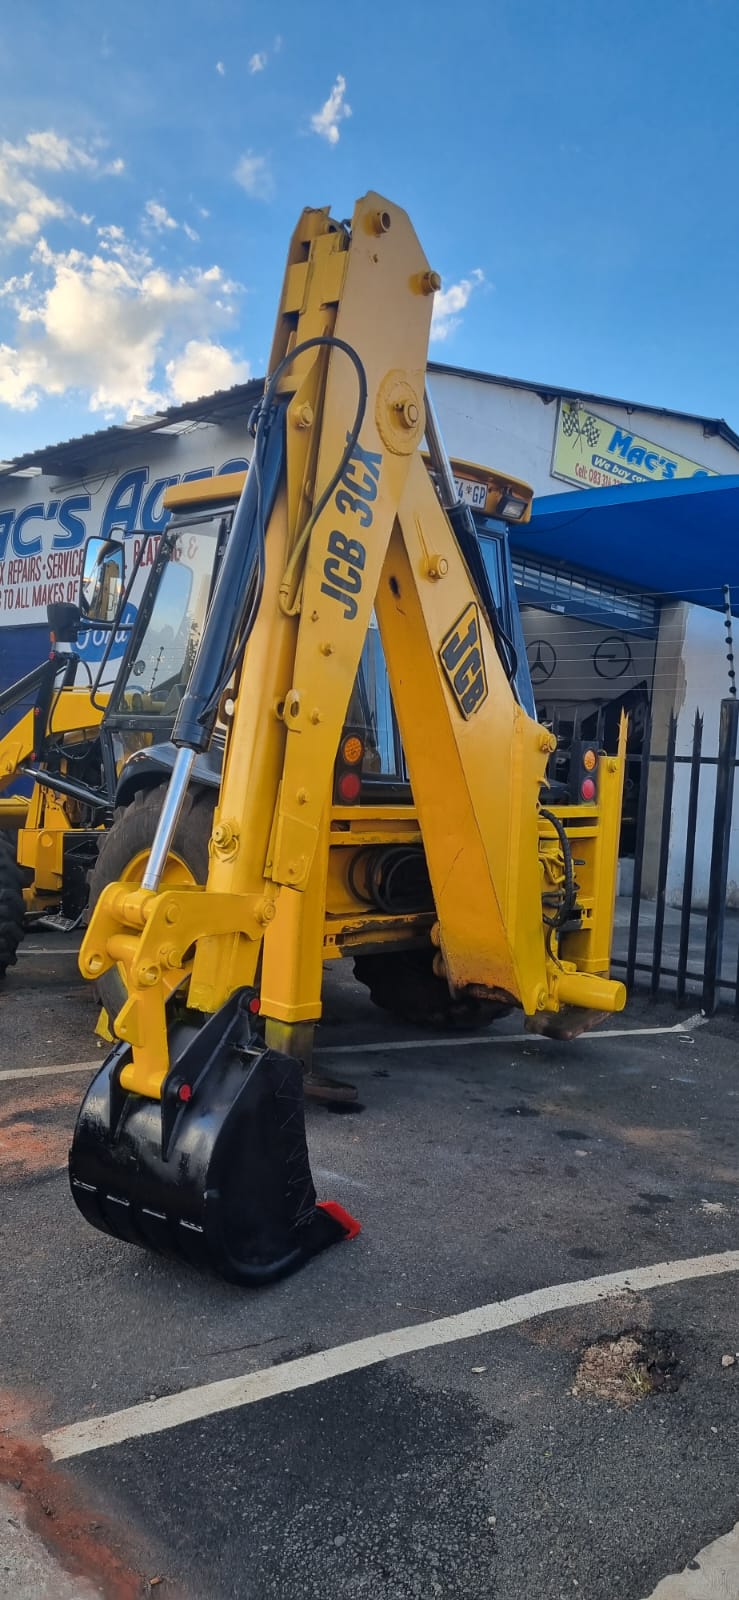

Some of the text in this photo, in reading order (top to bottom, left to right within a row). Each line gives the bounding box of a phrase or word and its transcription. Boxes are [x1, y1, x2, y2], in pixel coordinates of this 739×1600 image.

[594, 456, 611, 470] We
[612, 464, 631, 479] buy
[472, 485, 486, 505] GP
[320, 430, 383, 620] JCB 3CX
[7, 555, 42, 585] REPAIRS
[4, 580, 79, 610] TO ALL MAKES OF
[442, 618, 484, 714] JCB
